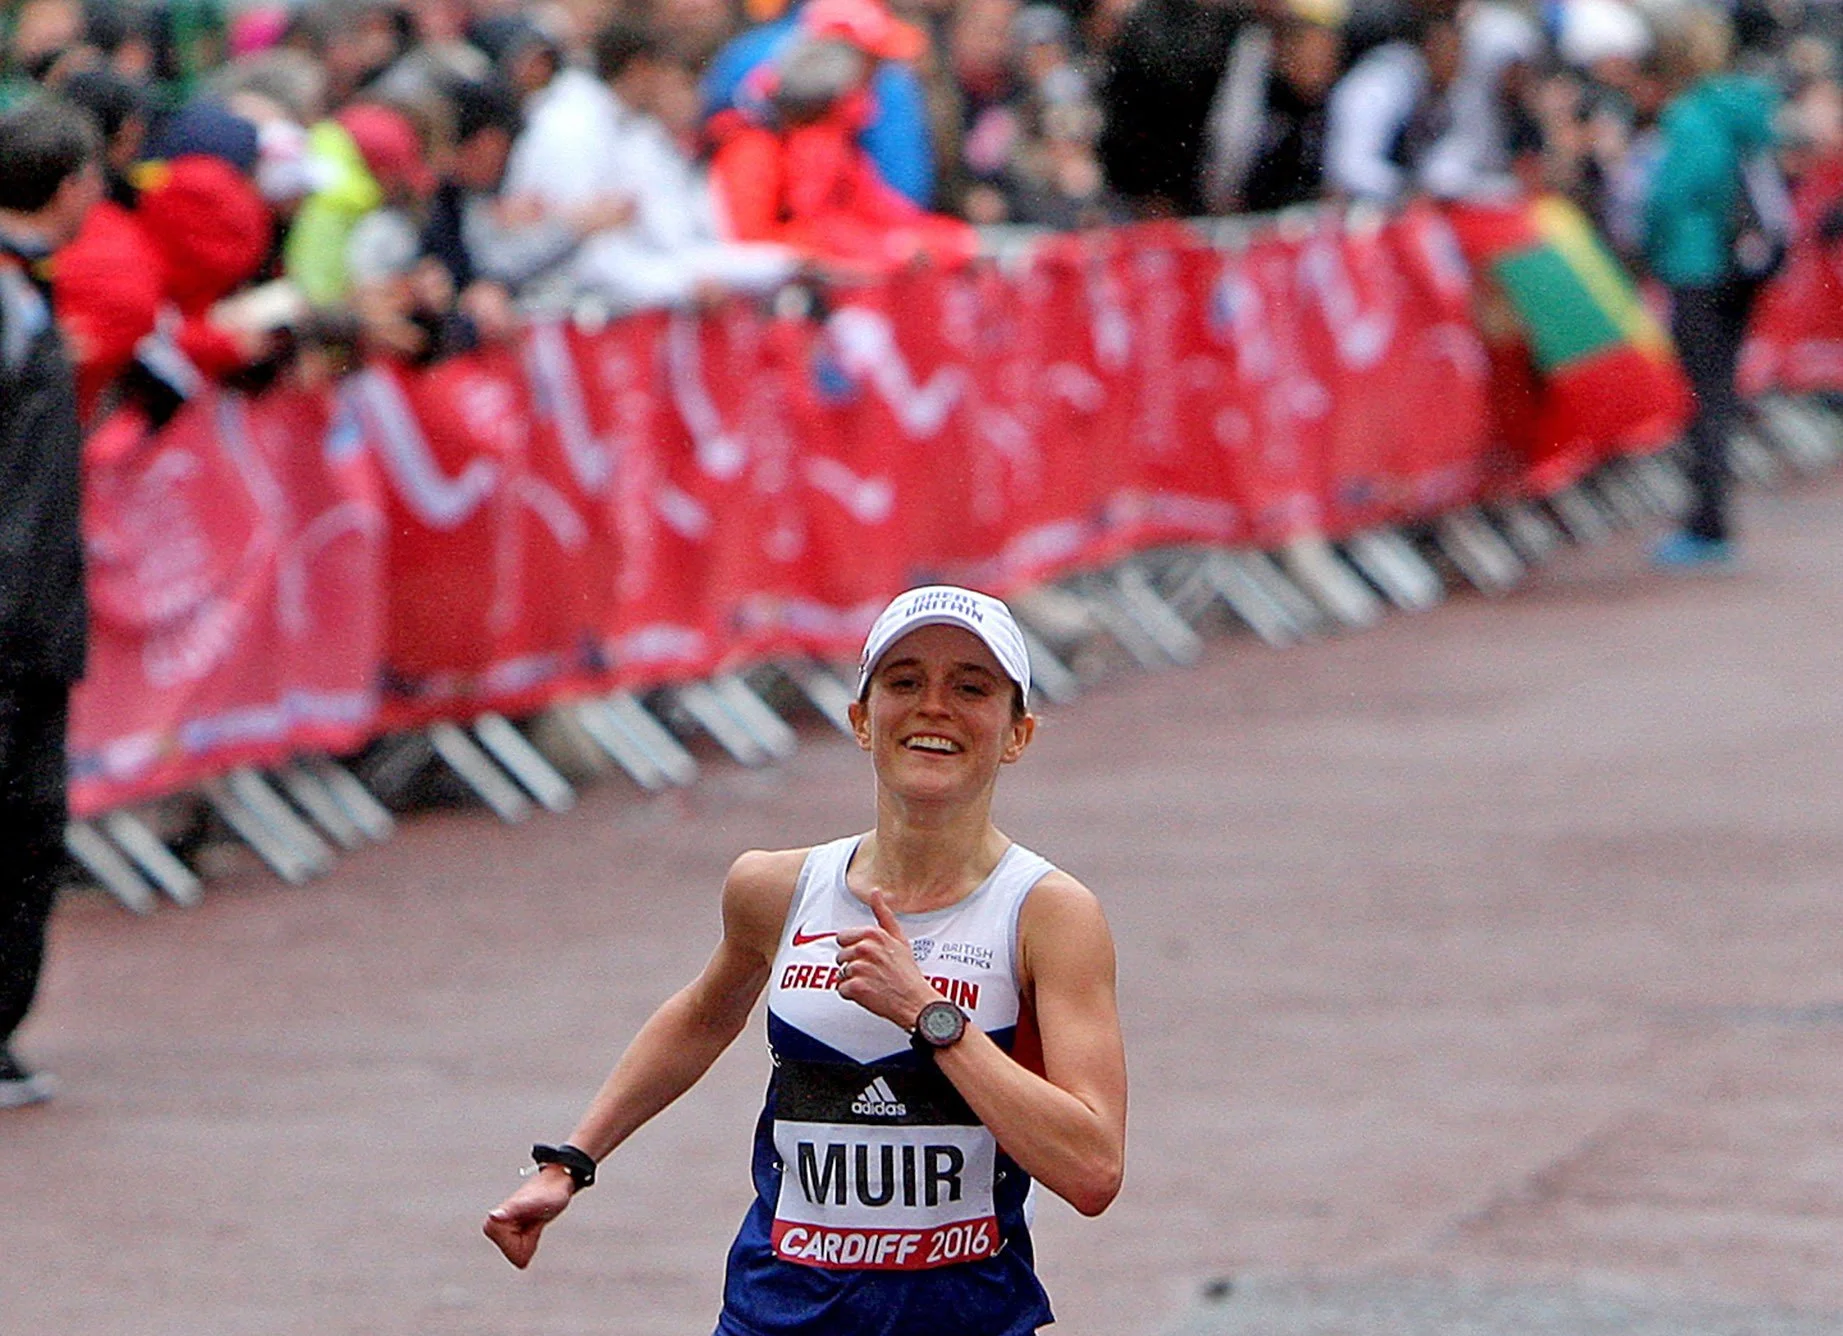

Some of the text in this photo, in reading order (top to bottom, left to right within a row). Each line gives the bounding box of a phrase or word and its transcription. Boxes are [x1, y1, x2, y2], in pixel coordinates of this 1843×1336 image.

[939, 954, 991, 969] ATHLETICS
[942, 943, 994, 959] BRITISH
[780, 964, 979, 1011] GREA AIN
[851, 1101, 907, 1116] adidas
[797, 1141, 965, 1208] MUIR
[780, 1222, 990, 1264] CARDIFF 2016
